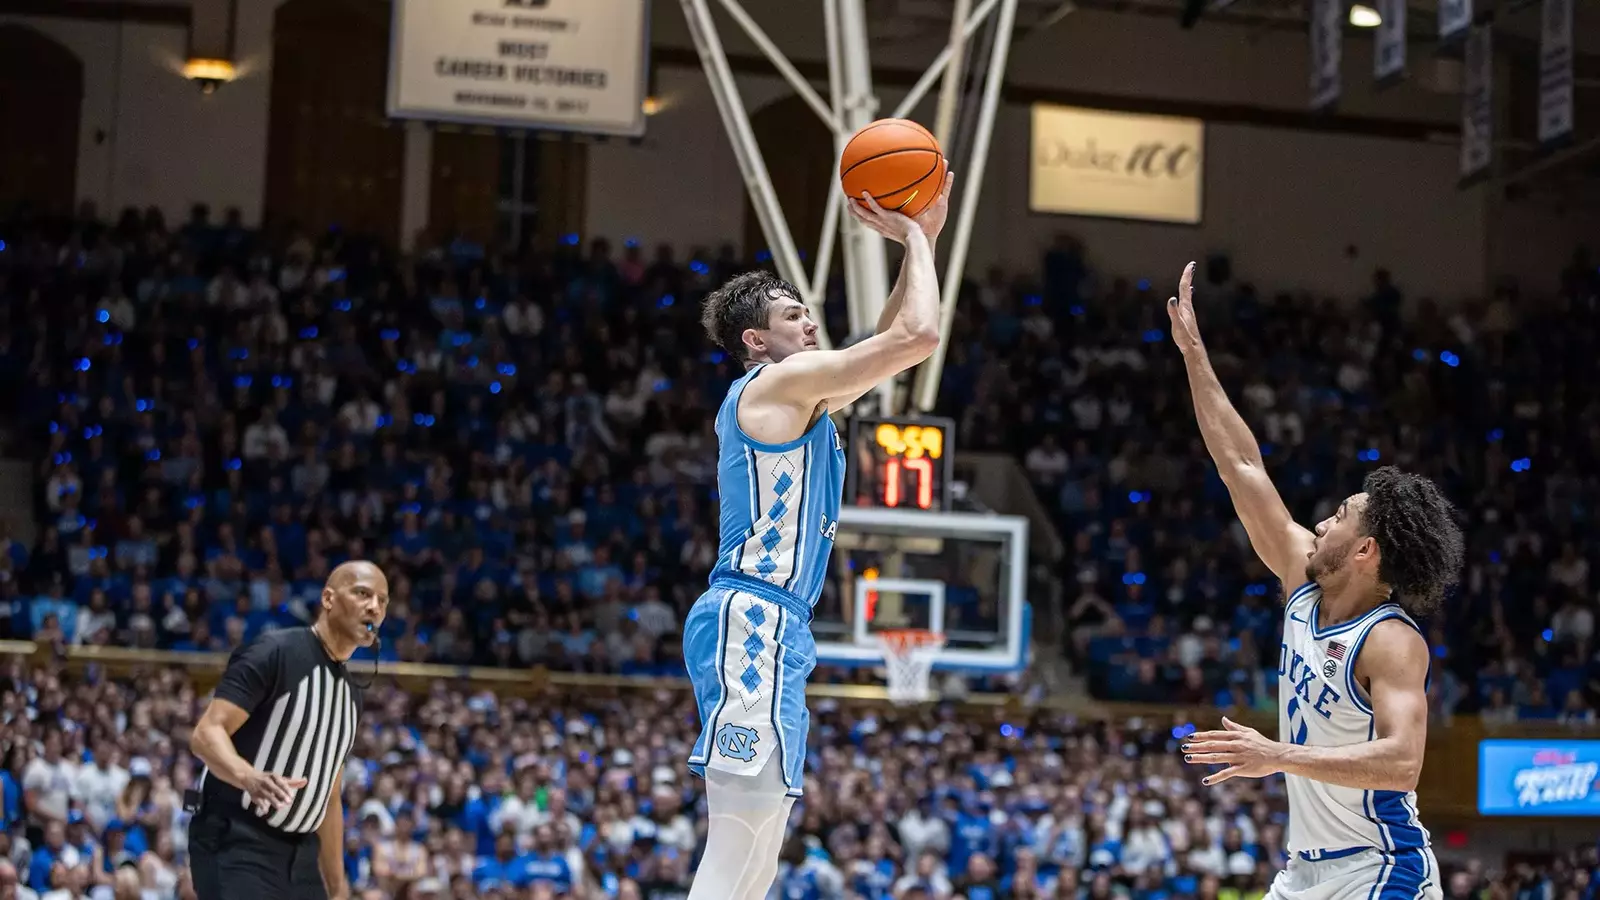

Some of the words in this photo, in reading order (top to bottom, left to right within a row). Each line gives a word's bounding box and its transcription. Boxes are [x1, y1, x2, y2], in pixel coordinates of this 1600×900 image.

[498, 40, 549, 58] MOST
[434, 57, 507, 81] CAREER
[513, 67, 607, 89] VICTORIES
[454, 91, 526, 108] NOVEMBER
[1037, 136, 1121, 173] Duke
[1125, 140, 1196, 179] 100
[884, 457, 933, 509] 17
[1277, 642, 1340, 719] DUKE
